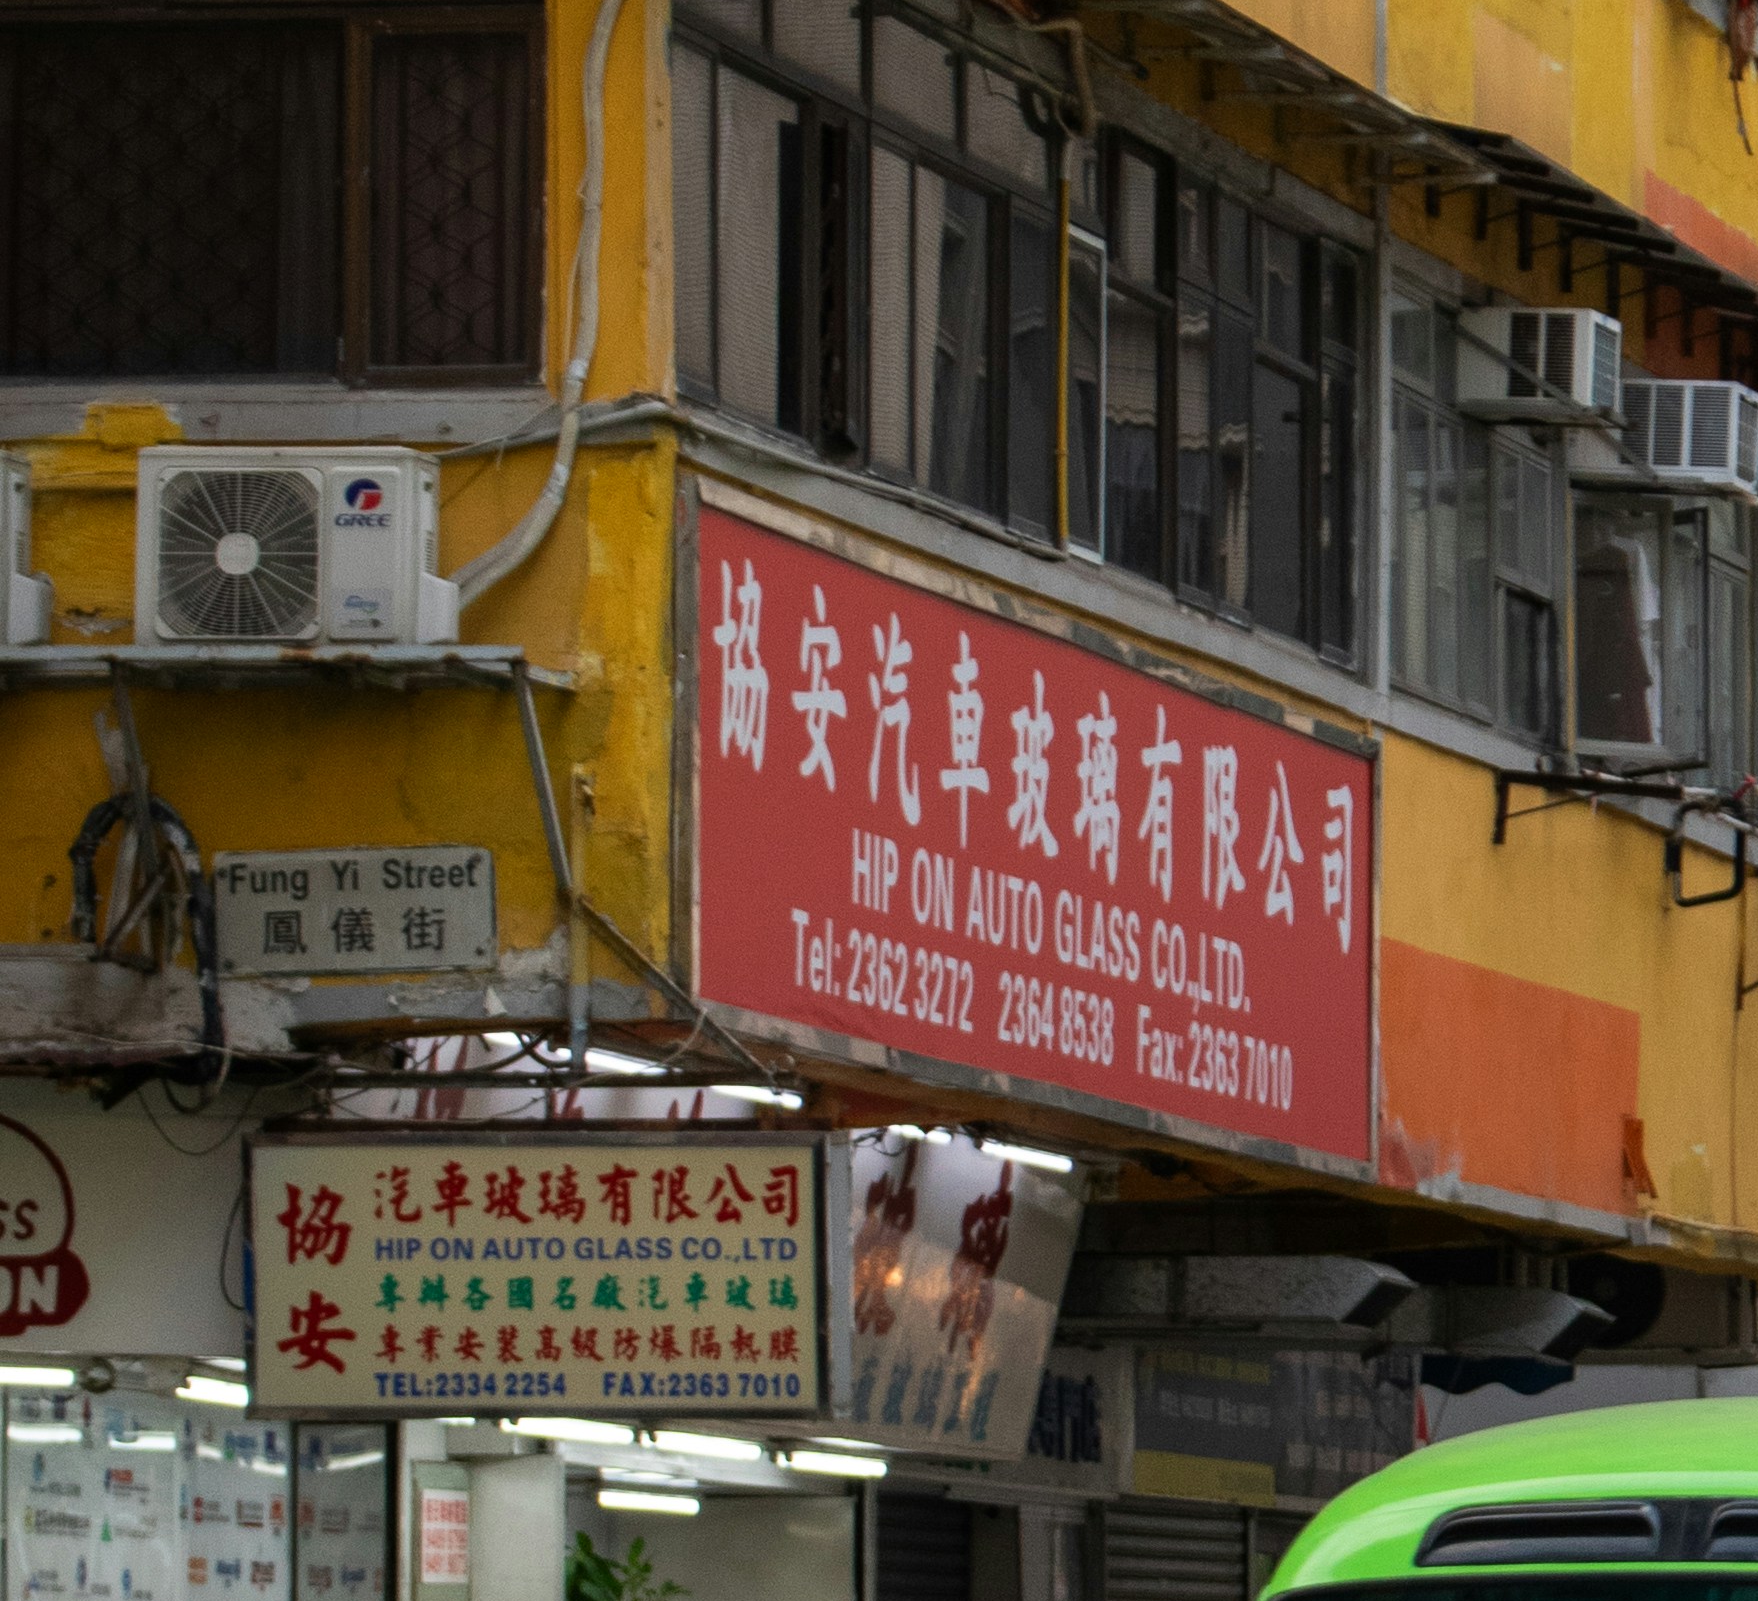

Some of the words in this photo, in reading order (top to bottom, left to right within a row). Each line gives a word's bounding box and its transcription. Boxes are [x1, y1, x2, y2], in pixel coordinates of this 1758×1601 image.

[335, 513, 391, 527] GREE
[713, 558, 1353, 954] 協安汽車玻璃有限公司
[228, 863, 309, 901] Fung
[330, 859, 361, 891] Yi
[382, 857, 479, 890] Street
[852, 827, 899, 915] HIP
[911, 847, 955, 932] ON
[966, 865, 1044, 955] AUTO
[1054, 889, 1141, 983] GLASS
[263, 906, 447, 954] 鳳儀街
[791, 907, 842, 997] Tel:
[847, 928, 909, 1017] 2362
[914, 947, 975, 1034] 3272
[998, 969, 1055, 1050] 2364
[1059, 985, 1115, 1067] 8538
[1136, 1003, 1184, 1084] Fax:
[1188, 1019, 1240, 1097] 2363
[1244, 1035, 1293, 1111] 7010
[373, 1160, 799, 1228] 汽車玻璃有限公司
[374, 1237, 422, 1261] HIP
[429, 1237, 475, 1261] ON
[482, 1237, 566, 1261] AUTO
[573, 1236, 674, 1261] GLASS
[277, 1181, 358, 1375] 協安
[503, 1372, 567, 1397] 2254
[738, 1372, 801, 1398] 7010
